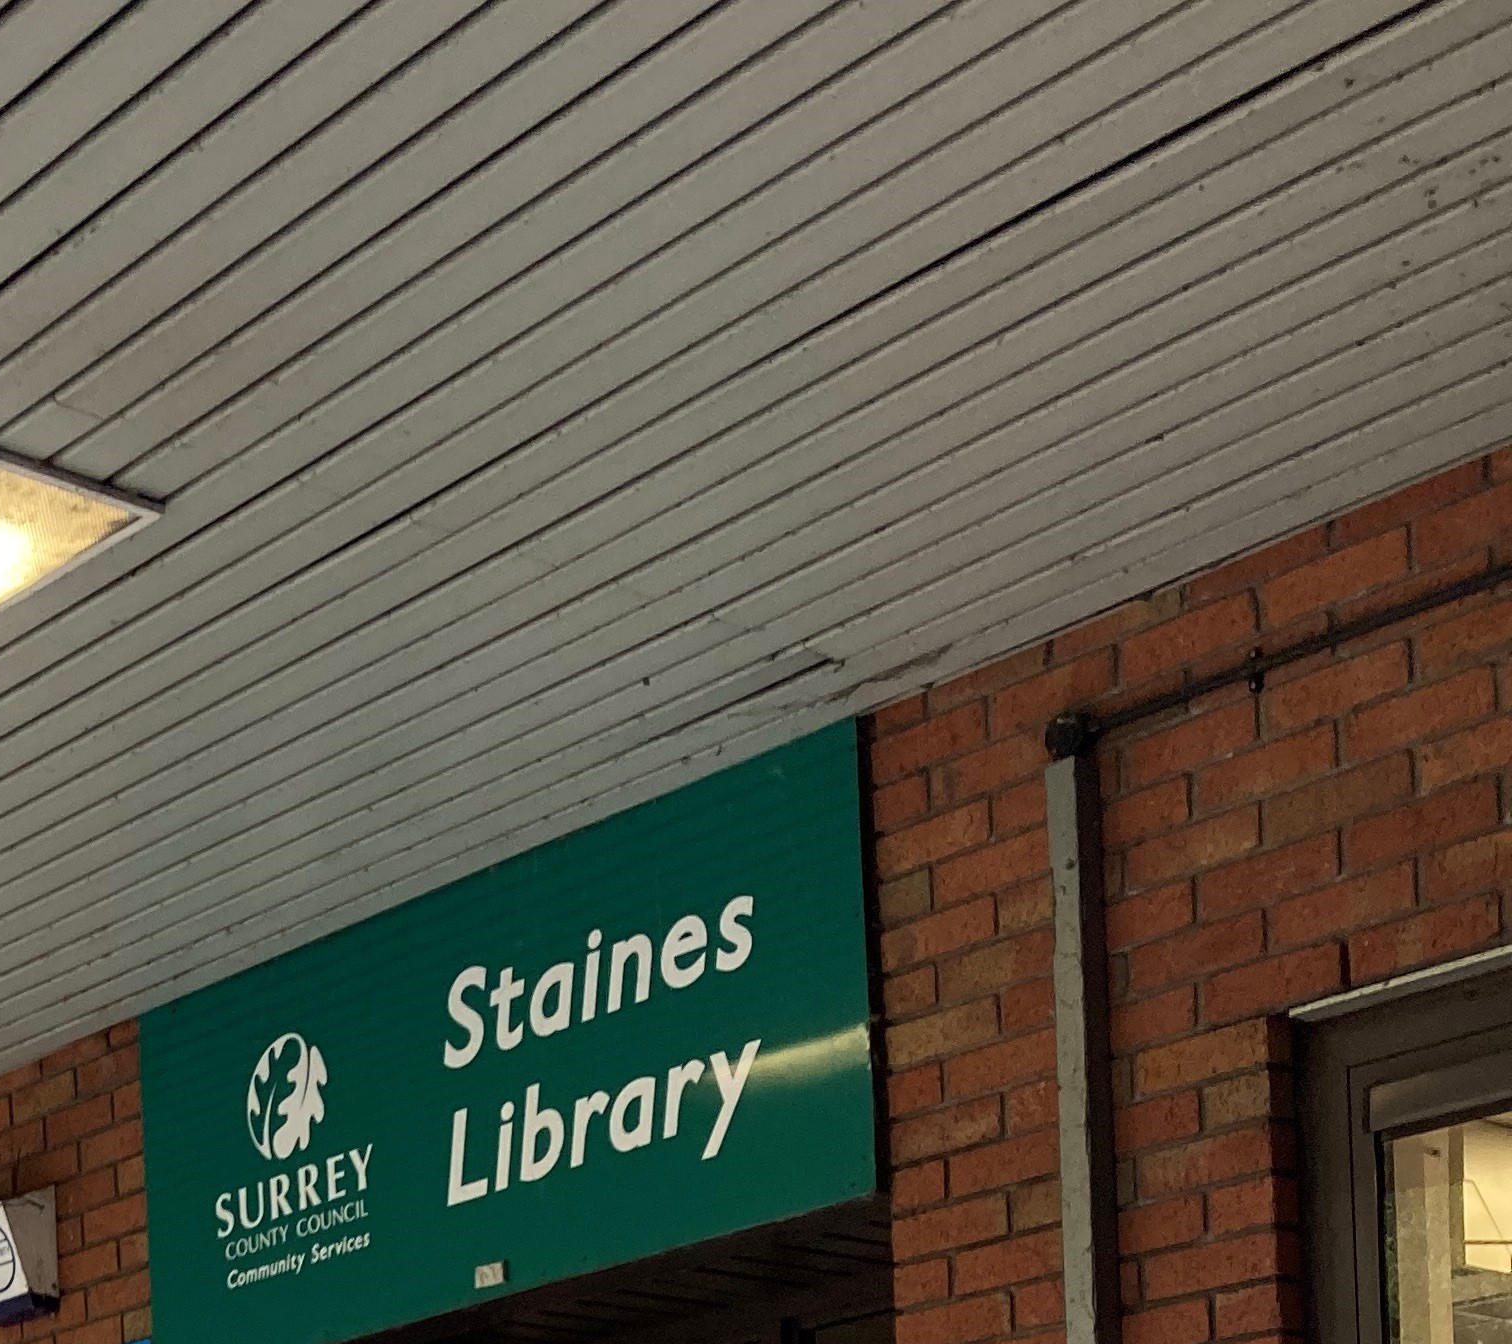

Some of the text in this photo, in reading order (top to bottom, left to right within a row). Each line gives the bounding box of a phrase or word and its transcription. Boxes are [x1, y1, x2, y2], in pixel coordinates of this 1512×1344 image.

[443, 895, 754, 1070] Staines
[446, 1038, 762, 1207] Library
[215, 1143, 374, 1239] SURREY
[225, 1199, 369, 1262] COUNTY COUNCIL
[226, 1232, 371, 1290] Community Services
